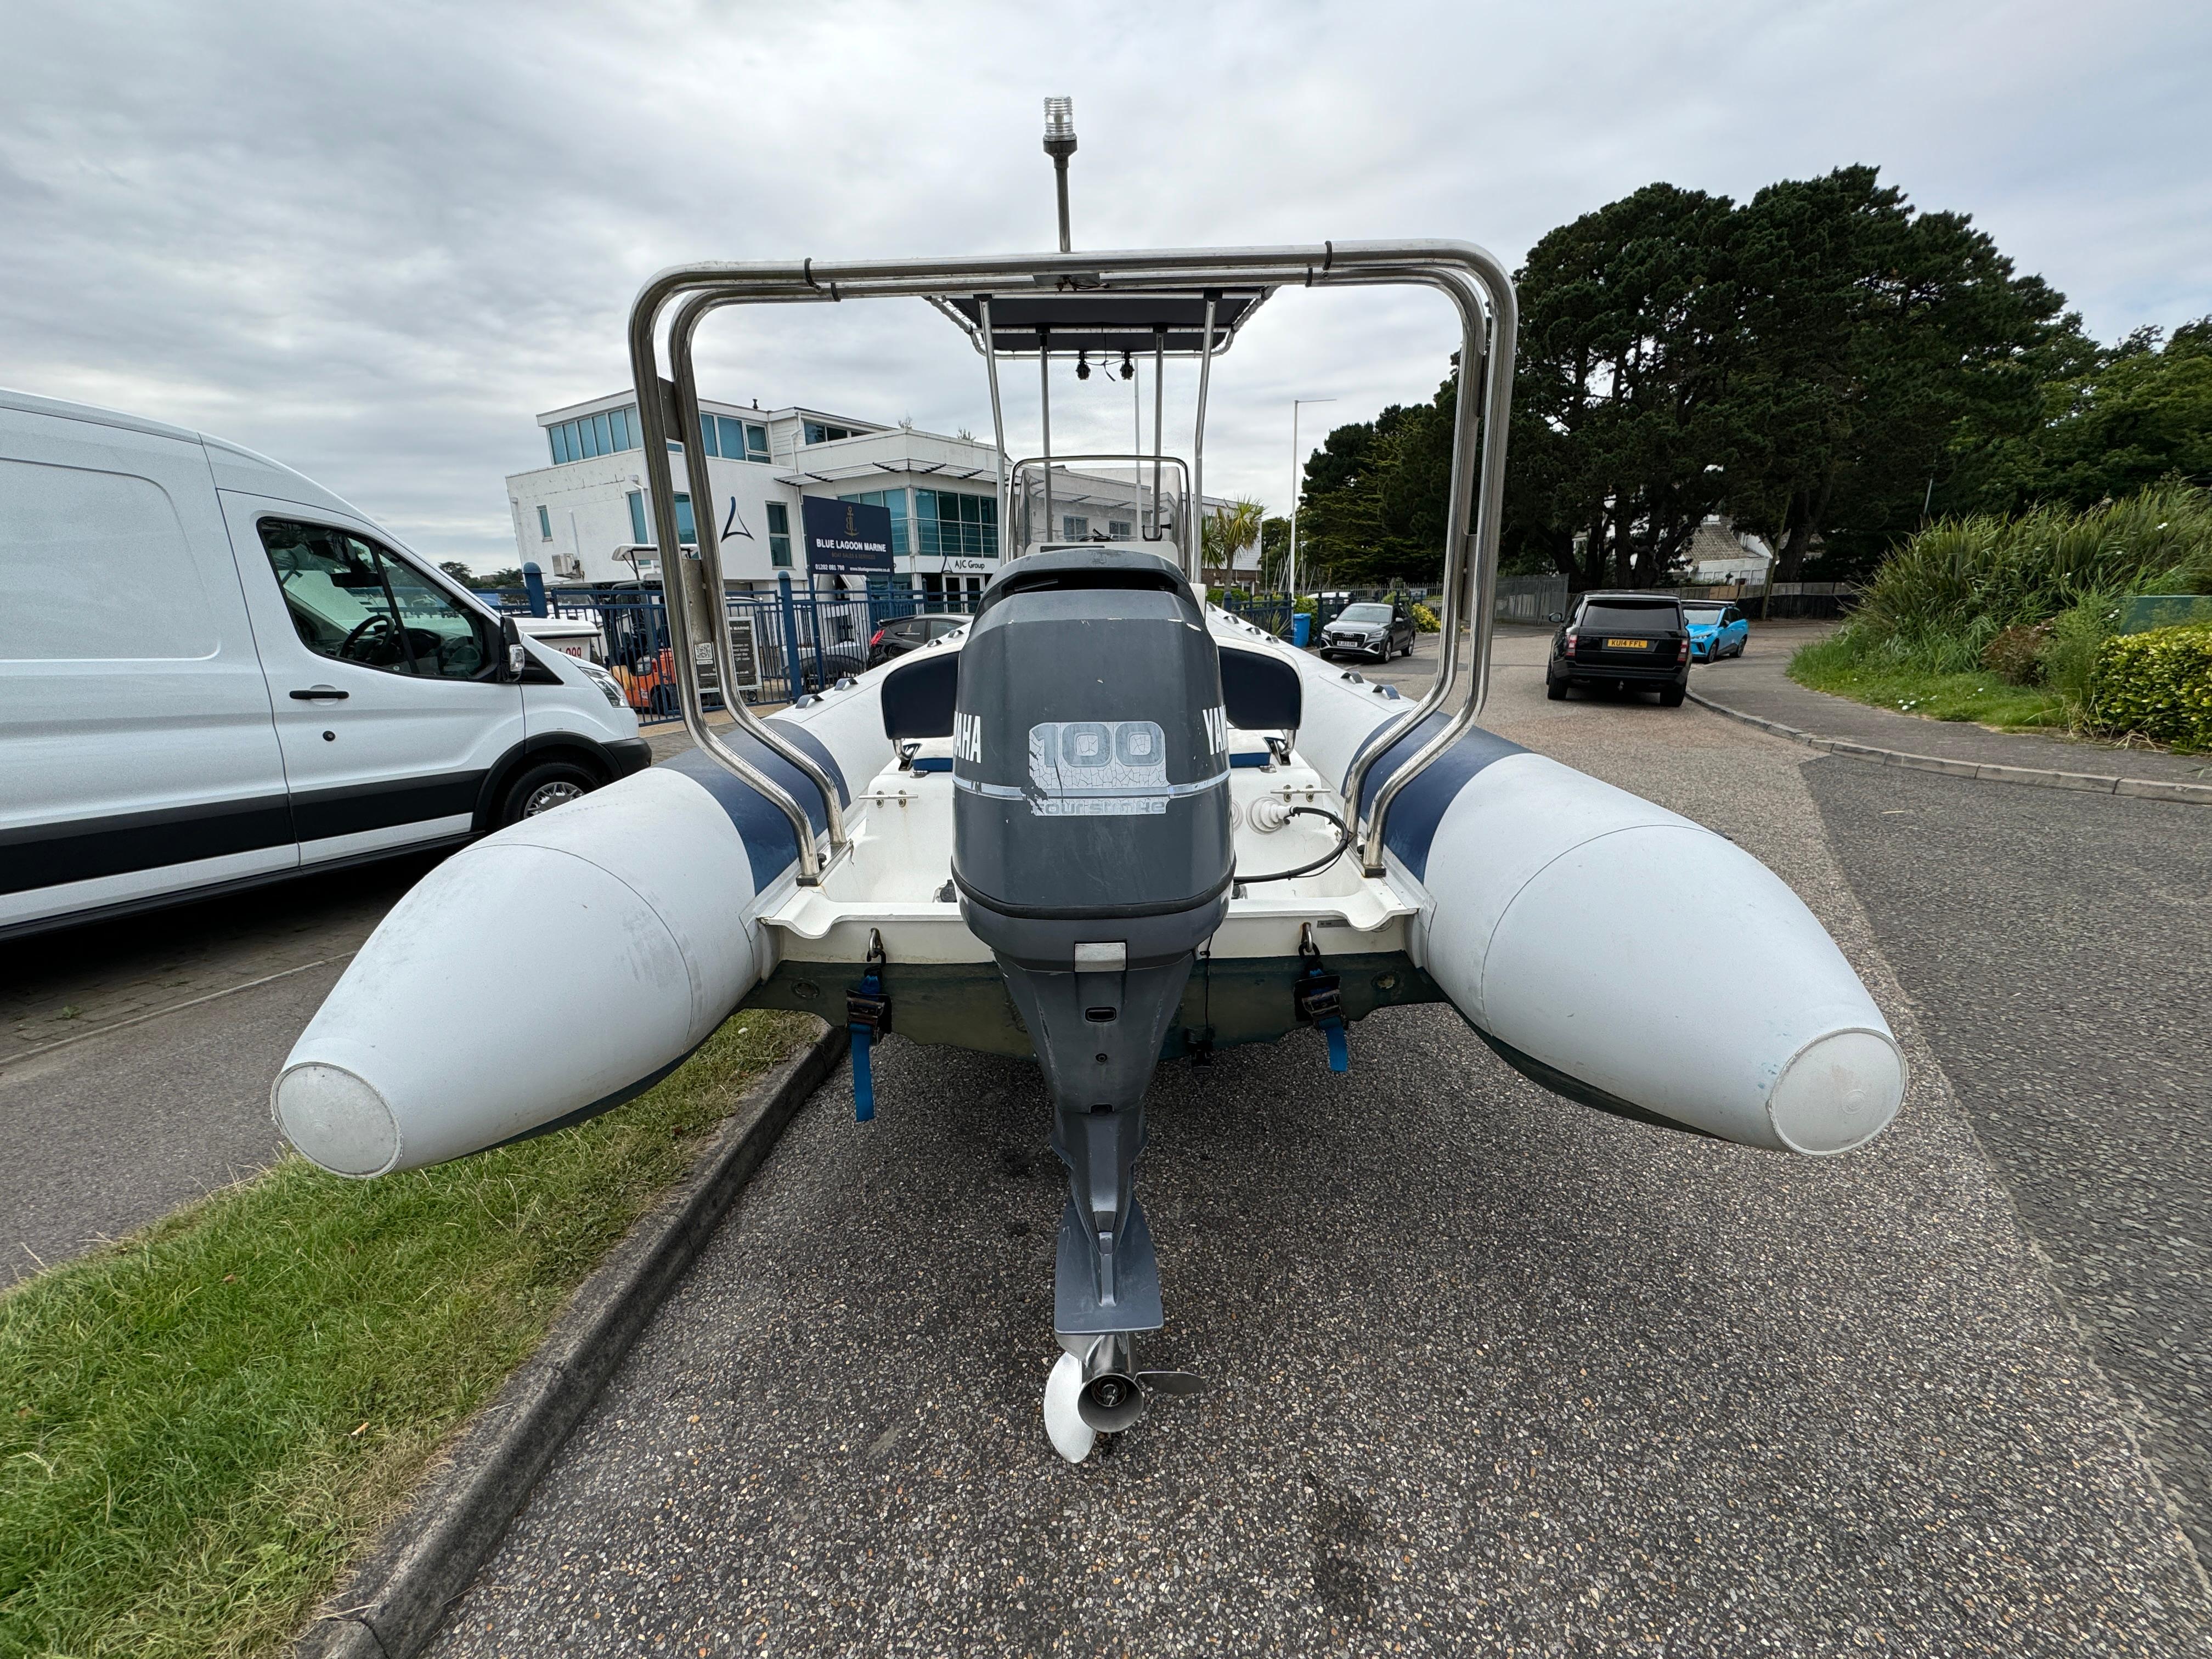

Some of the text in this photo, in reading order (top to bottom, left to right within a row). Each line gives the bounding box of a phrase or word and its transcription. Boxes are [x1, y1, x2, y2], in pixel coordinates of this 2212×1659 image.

[816, 538, 887, 552] BLUE LAGOON MARINE
[955, 560, 985, 570] AJC Group
[954, 711, 981, 764] AHA
[1031, 722, 1166, 768] 100
